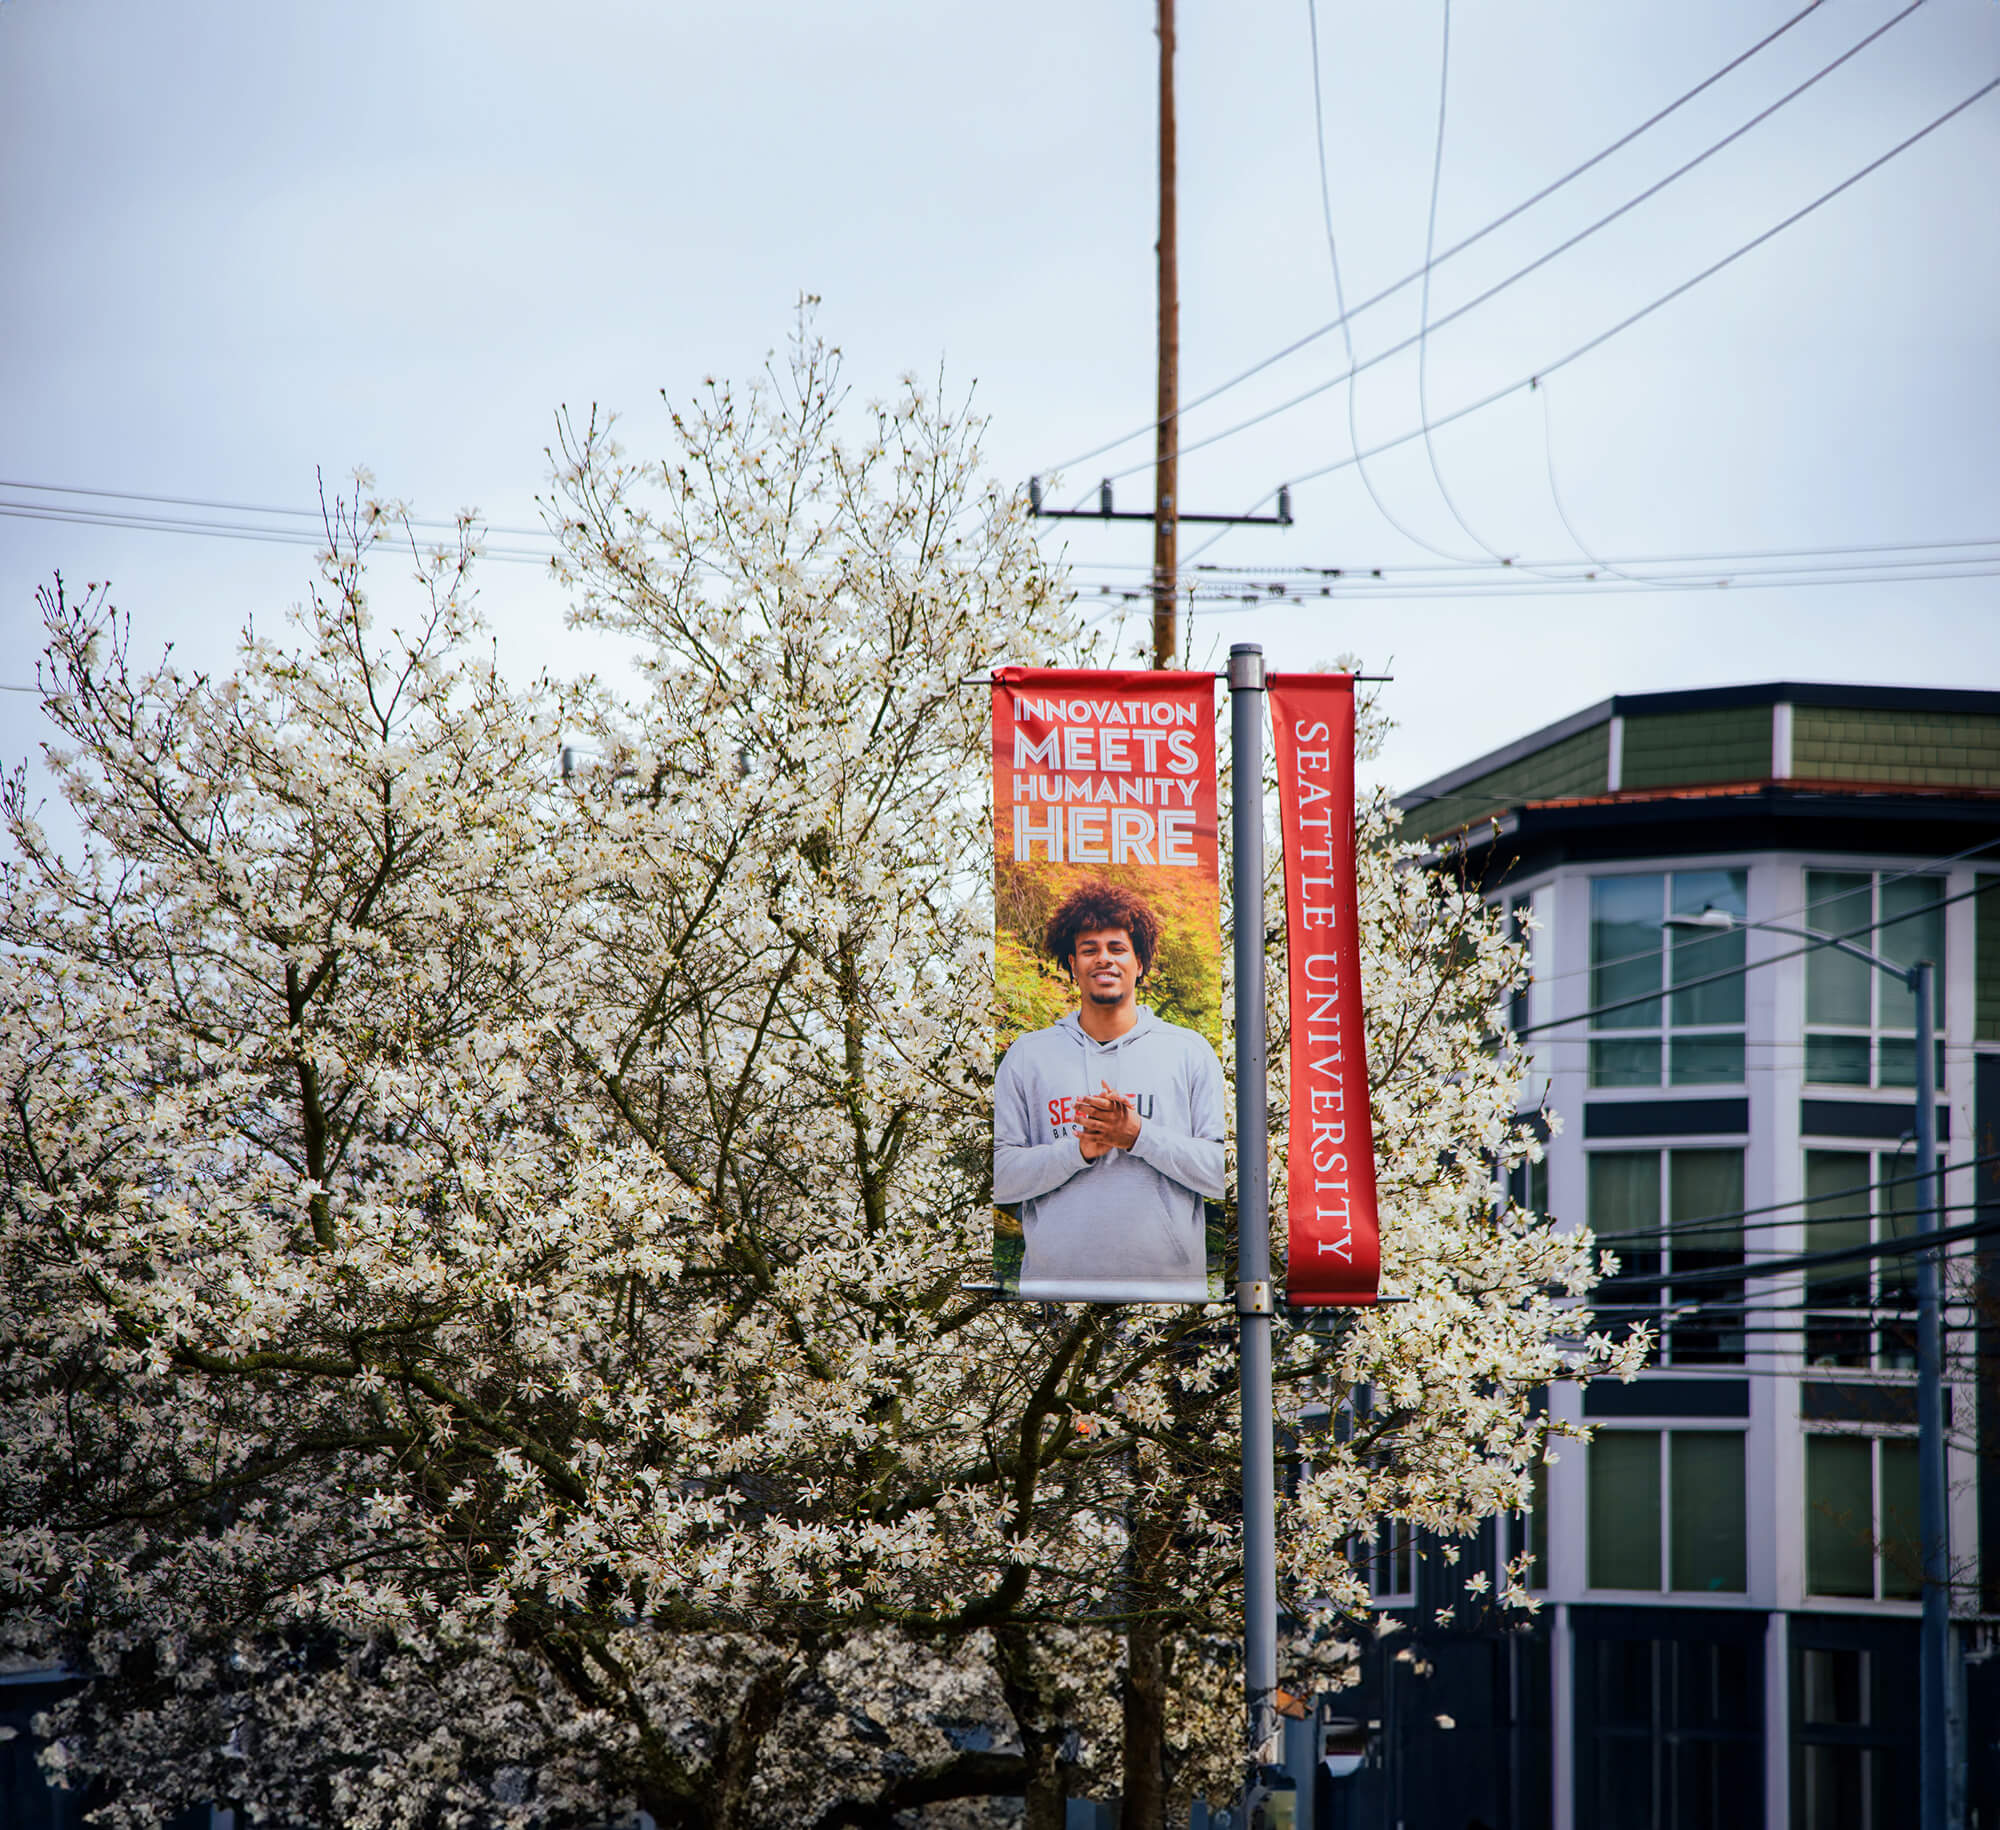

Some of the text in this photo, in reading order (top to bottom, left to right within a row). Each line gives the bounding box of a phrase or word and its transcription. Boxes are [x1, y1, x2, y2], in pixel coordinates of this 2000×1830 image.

[1014, 696, 1197, 726] INNOVATION
[1013, 725, 1199, 774] MEETS
[1013, 774, 1200, 807] HUMANITY
[1013, 805, 1198, 867] HERE
[1295, 720, 1353, 1265] SEATTLE UNIVERSITY
